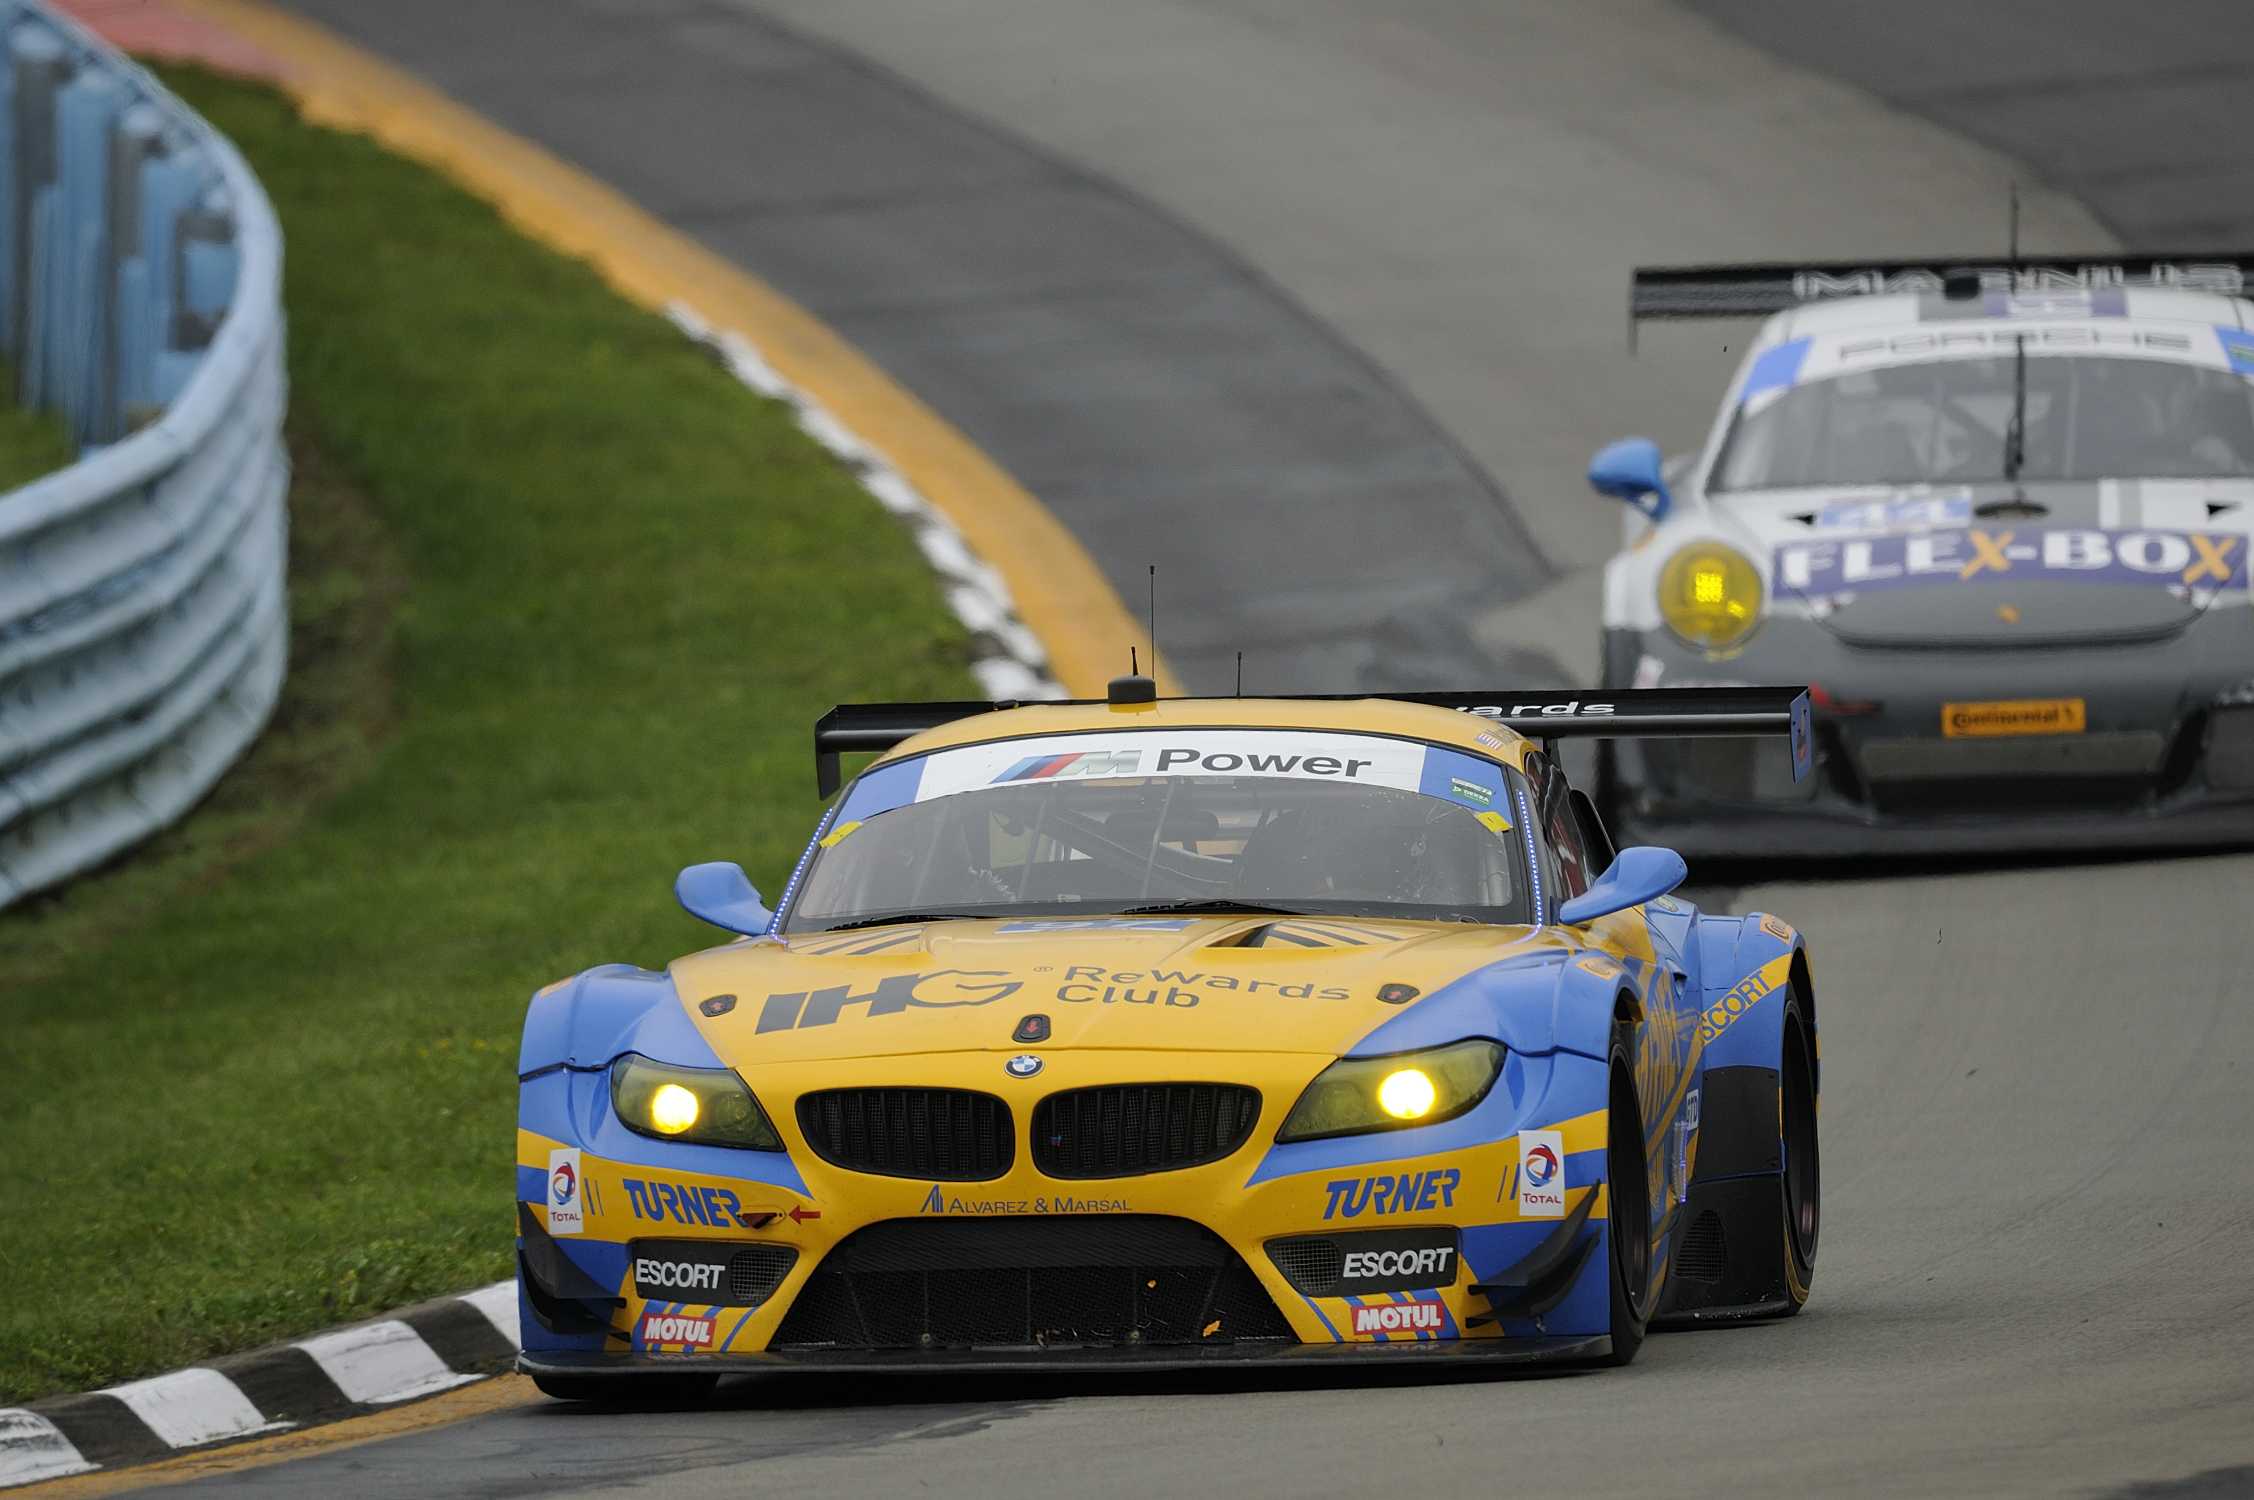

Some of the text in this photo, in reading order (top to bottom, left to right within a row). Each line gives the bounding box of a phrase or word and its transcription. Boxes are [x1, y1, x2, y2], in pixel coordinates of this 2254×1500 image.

[1783, 530, 2236, 587] FLEX-BOX
[1456, 701, 1615, 716] ards
[1156, 748, 1372, 778] Power
[1056, 984, 1200, 1008] Club
[1064, 966, 1350, 1000] Rewards
[755, 969, 1024, 1035] IHG
[1699, 968, 1771, 1042] SCORT
[623, 1178, 749, 1229] TURNER
[949, 1196, 1133, 1214] ALVAREZ & MARSAL
[1323, 1168, 1460, 1220] TURNER
[1523, 1192, 1562, 1205] TOTAL
[551, 1211, 581, 1222] TOTAL
[635, 1258, 725, 1289] ESCORT
[1342, 1247, 1453, 1278] ESCORT
[644, 1316, 711, 1343] MOTUL
[1356, 1304, 1441, 1332] MOTUL
